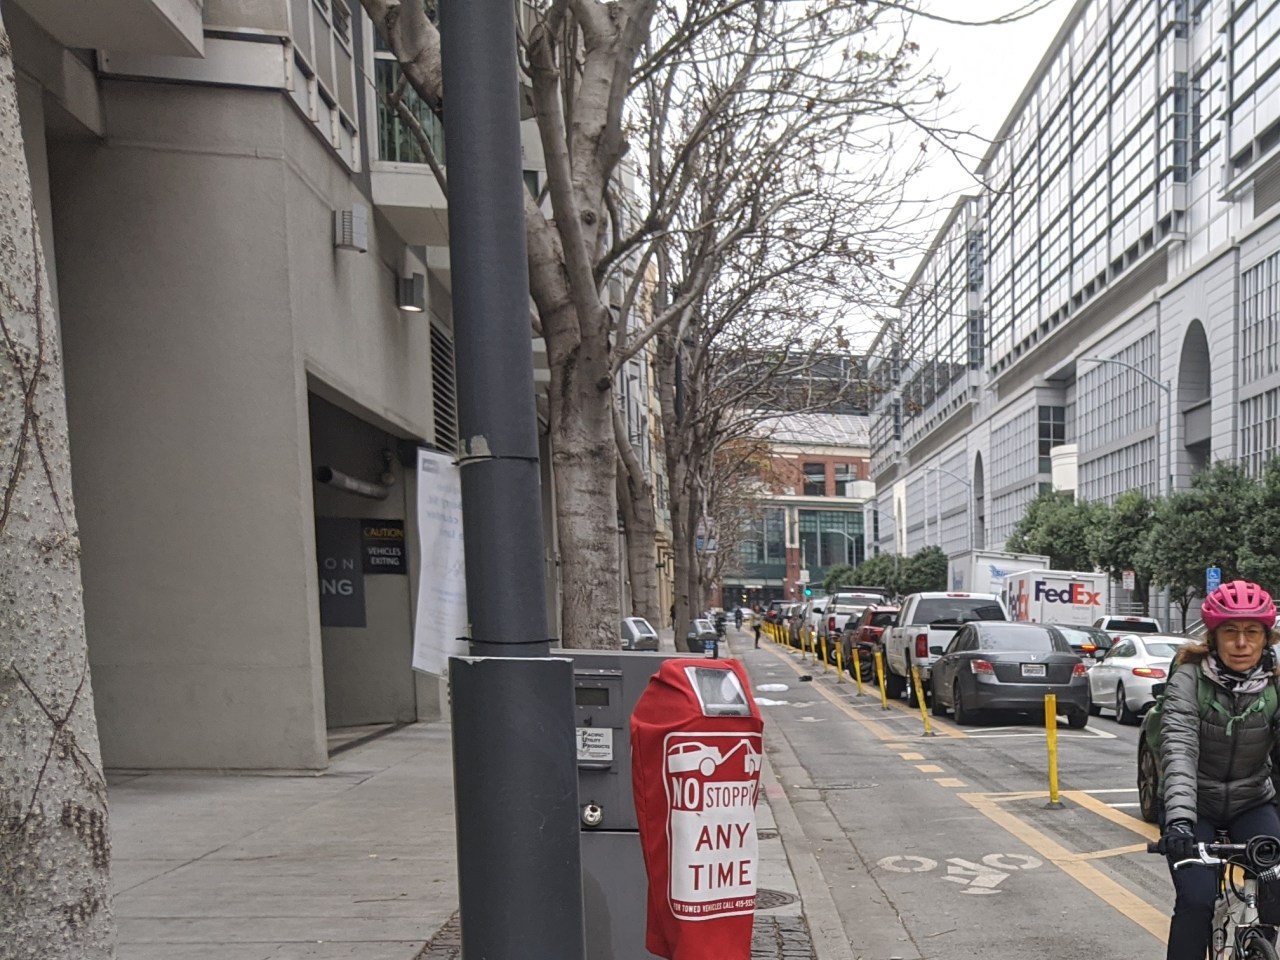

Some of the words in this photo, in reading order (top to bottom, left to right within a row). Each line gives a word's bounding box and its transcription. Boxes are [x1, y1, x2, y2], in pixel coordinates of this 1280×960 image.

[363, 528, 403, 538] CAUTION
[368, 547, 401, 556] VEHICLES
[371, 557, 400, 566] EXITING
[1034, 580, 1101, 606] FedEx
[672, 777, 700, 810] NO
[705, 784, 755, 808] STOPPI
[695, 822, 750, 852] ANY
[688, 860, 751, 891] TIME
[682, 904, 701, 914] TOWED
[702, 902, 723, 913] VEHICLES
[723, 901, 734, 909] CALL
